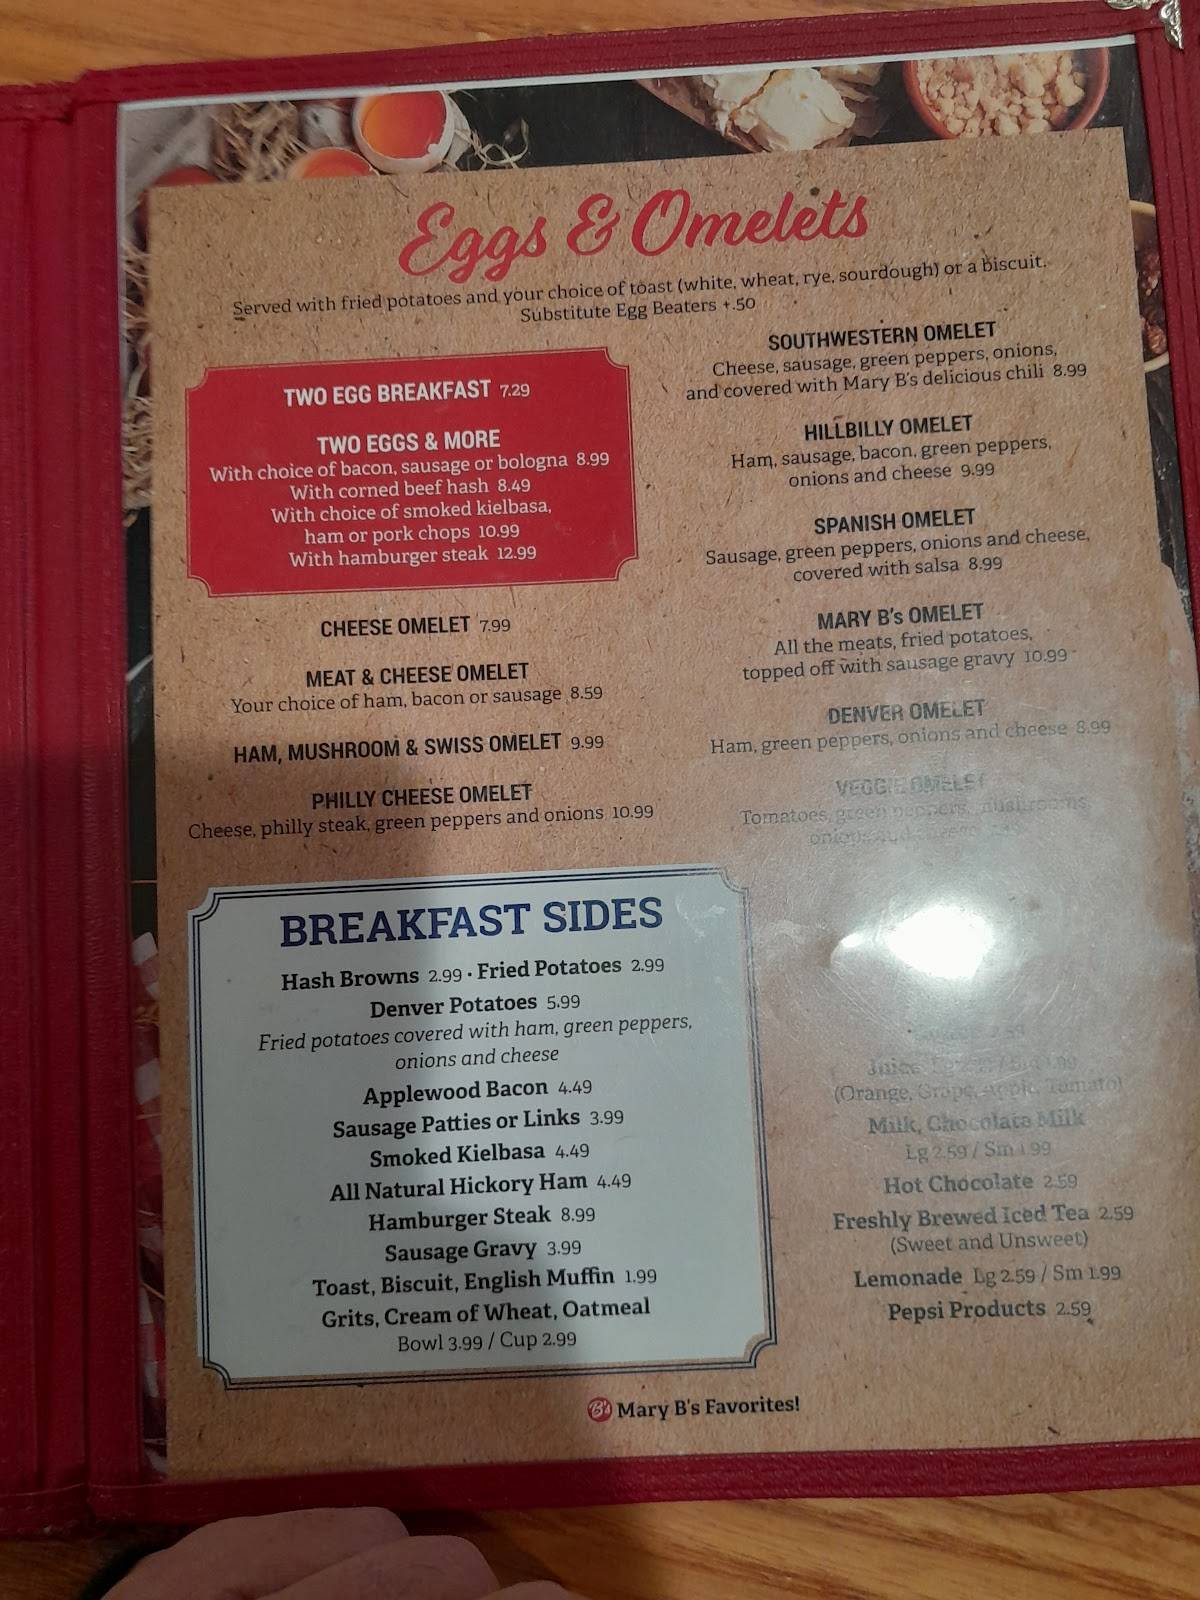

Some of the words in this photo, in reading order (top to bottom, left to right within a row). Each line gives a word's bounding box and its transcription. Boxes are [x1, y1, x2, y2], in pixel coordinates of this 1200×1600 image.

[399, 200, 547, 283] Eggs
[567, 193, 620, 256] &
[631, 188, 870, 257] Omelets
[233, 298, 291, 316] Served
[296, 296, 335, 311] with
[341, 294, 381, 309] fried
[387, 294, 461, 311] potatoes
[466, 288, 498, 304] and
[503, 288, 543, 304] your
[548, 283, 603, 299] choice
[607, 282, 625, 296] of
[630, 280, 672, 294] toast
[678, 269, 736, 293] (white,
[740, 272, 798, 287] wheat,
[803, 272, 834, 287] rye,
[839, 261, 938, 281] sourdough)
[944, 263, 962, 274] or
[968, 262, 977, 273] a
[981, 254, 1046, 271] biscuit.
[521, 306, 610, 322] Substitute
[617, 302, 647, 320] Egg
[653, 300, 716, 314] Beaters
[723, 297, 755, 311] +.50
[768, 327, 917, 350] SOUTHWESTERN
[924, 321, 996, 340] OMELET
[712, 361, 778, 376] Cheese,
[783, 357, 855, 372] sausage,
[860, 354, 909, 371] green
[914, 346, 988, 367] peppers,
[993, 343, 1056, 364] onions,
[284, 387, 326, 406] TWO
[333, 385, 370, 404] EGG
[378, 379, 490, 401] BREAKFAST
[500, 383, 529, 397] 7.29
[804, 419, 893, 440] HILLBILLY
[900, 414, 972, 434] OMELET
[317, 435, 360, 454] TWO
[367, 433, 418, 452] EGGS
[425, 432, 438, 450] &
[444, 429, 500, 449] MORE
[731, 453, 776, 468] Ham,
[782, 450, 854, 465] sausage,
[858, 445, 916, 460] bacon,
[921, 443, 970, 459] green
[976, 438, 1051, 456] peppers,
[209, 465, 252, 481] With
[257, 463, 313, 479] choice
[318, 461, 337, 476] of
[340, 460, 397, 475] bacon,
[401, 460, 469, 475] sausage
[475, 459, 493, 470] or
[497, 453, 568, 471] bologna
[577, 452, 609, 466] 8.99
[290, 484, 333, 499] With
[339, 481, 399, 498] corned
[404, 479, 442, 495] beef
[446, 479, 488, 494] hash
[498, 478, 530, 492] 8.49
[814, 514, 895, 534] SPANISH
[902, 508, 975, 528] OMELET
[321, 618, 392, 636] CHEESE
[398, 616, 470, 634] OMELET
[480, 619, 510, 632] 7.99
[818, 610, 871, 629] MARY
[877, 607, 903, 625] B's
[909, 603, 983, 623] OMELET
[306, 669, 355, 687] MEAT
[362, 668, 373, 685] &
[380, 666, 451, 684] CHEESE
[457, 662, 528, 681] OMELET
[826, 705, 903, 724] DENVER
[910, 699, 984, 719] OMELET
[234, 745, 281, 764] HAM,
[288, 740, 399, 760] MUSHROOM
[406, 739, 418, 756] &
[424, 736, 483, 754] SWISS
[489, 732, 561, 751] OMELET
[571, 735, 603, 749] 9.99
[312, 790, 375, 809] PHILLY
[382, 787, 454, 806] CHEESE
[459, 783, 532, 802] OMELET
[280, 904, 530, 946] BREAKFAST
[543, 897, 662, 932] SIDES
[281, 971, 334, 990] Hash
[340, 970, 418, 987] Browns
[428, 968, 461, 982] 2.99
[477, 960, 530, 979] Fried
[534, 959, 621, 976] Potatoes
[631, 958, 664, 972] 2.99
[370, 1001, 444, 1017] Denver
[449, 996, 536, 1013] Potatoes
[547, 994, 580, 1009] 5.99
[362, 1081, 480, 1108] Applewood
[486, 1080, 548, 1097] Bacon
[558, 1079, 591, 1094] 4.49
[334, 1121, 416, 1139] Sausage
[421, 1113, 490, 1132] Patties
[496, 1115, 518, 1128] or
[523, 1108, 580, 1127] Links
[590, 1110, 623, 1125] 3.99
[370, 1146, 451, 1167] Smoked
[457, 1143, 545, 1162] Kielbasa
[555, 1143, 588, 1158] 4.49
[330, 1183, 359, 1201] All
[365, 1178, 444, 1199] Natural
[450, 1176, 534, 1195] Hickory
[539, 1172, 587, 1190] Ham
[597, 1173, 630, 1188] 4.49
[884, 1177, 923, 1194] Hot
[928, 1173, 1033, 1192] Chocolate
[1044, 1173, 1077, 1188] 2.59
[368, 1212, 487, 1231] Hamburger
[494, 1205, 551, 1224] Steak
[561, 1207, 594, 1222] 8.99
[832, 1210, 912, 1232] Freshly
[917, 1207, 997, 1226] Brewed
[1002, 1204, 1046, 1223] Iced
[1051, 1204, 1089, 1221] Tea
[1099, 1206, 1133, 1220] 2.59
[385, 1245, 468, 1263] Sausage
[474, 1240, 536, 1260] Gravy
[548, 1240, 580, 1255] 3.99
[312, 1279, 374, 1296] Toast,
[381, 1274, 458, 1293] Biscuit,
[464, 1270, 541, 1293] English
[547, 1266, 614, 1286] Muffin
[626, 1269, 656, 1283] 1.99
[854, 1267, 962, 1287] Lemonade
[974, 1268, 996, 1288] Lg
[1000, 1268, 1034, 1284] 2.59
[1041, 1265, 1046, 1282] /
[1054, 1264, 1082, 1280] Sm
[1089, 1266, 1120, 1280] 1.99
[322, 1309, 378, 1327] Grits,
[384, 1308, 451, 1324] Cream
[457, 1303, 479, 1322] of
[484, 1303, 557, 1320] Wheat,
[562, 1297, 650, 1317] Oatmeal
[888, 1301, 944, 1324] Pepsi
[949, 1300, 1045, 1318] Products
[1056, 1301, 1090, 1316] 2.59
[398, 1334, 442, 1351] Bowl
[448, 1336, 482, 1351] 3.99
[488, 1331, 494, 1350] /
[500, 1331, 537, 1350] Cup
[542, 1332, 576, 1346] 2.99
[617, 1402, 668, 1420] Mary
[675, 1399, 699, 1415] B's
[706, 1396, 799, 1414] Favorites!
